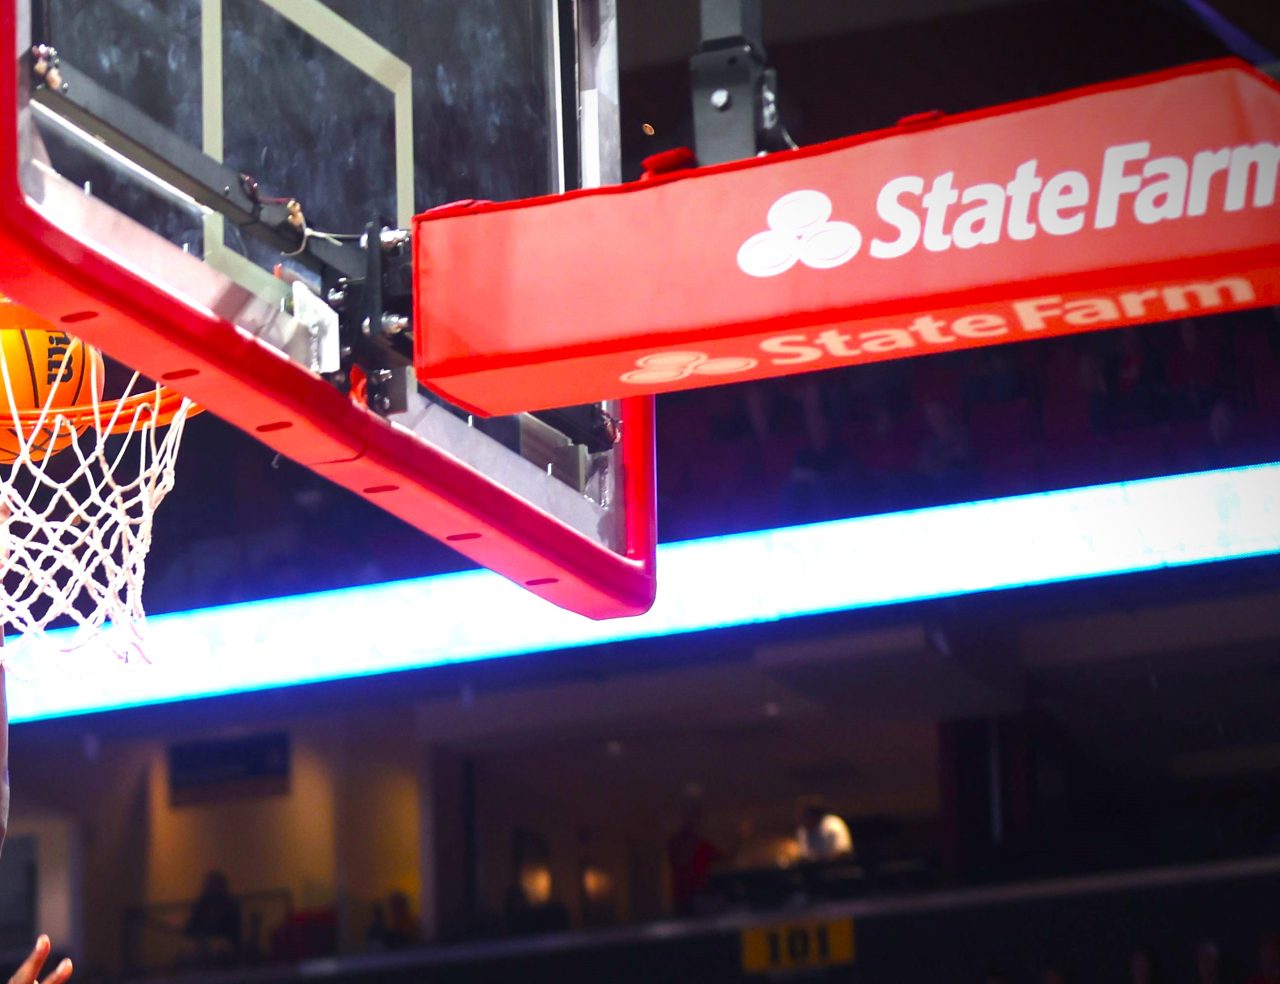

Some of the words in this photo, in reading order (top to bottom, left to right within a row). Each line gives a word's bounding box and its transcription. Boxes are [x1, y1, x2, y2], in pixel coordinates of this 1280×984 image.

[869, 159, 1090, 259] State
[760, 311, 1009, 366] State
[1012, 277, 1255, 332] Farm
